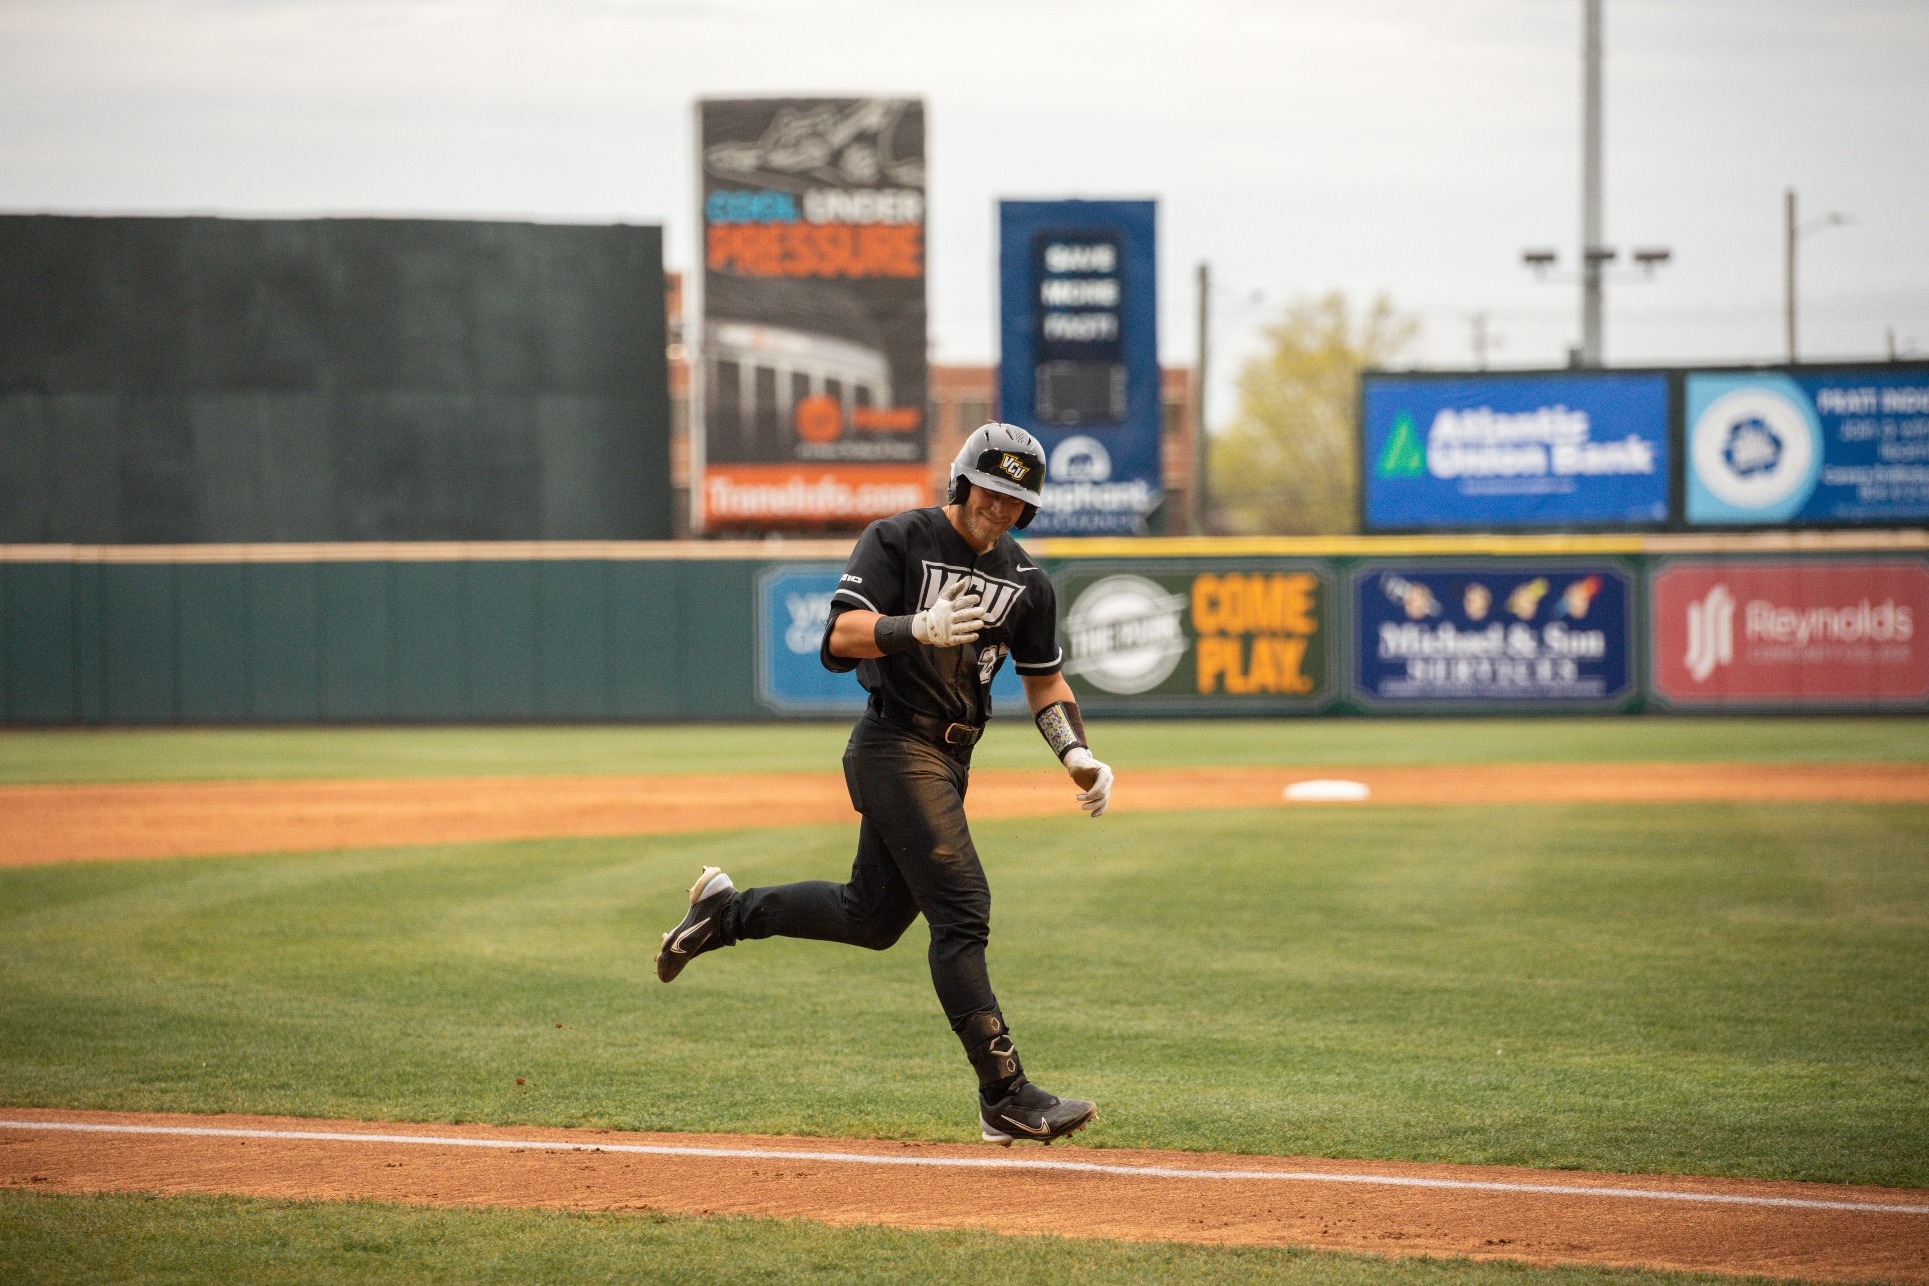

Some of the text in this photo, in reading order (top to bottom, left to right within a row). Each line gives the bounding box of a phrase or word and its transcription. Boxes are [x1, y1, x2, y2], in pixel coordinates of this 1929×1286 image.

[805, 189, 921, 223] UNDER
[709, 222, 921, 276] PRESSURE
[1430, 405, 1588, 443] Atlantic
[1001, 453, 1030, 480] VCU
[1551, 434, 1652, 475] Bank
[1191, 572, 1318, 635] COME
[1746, 598, 1913, 647] Reynolds
[1379, 620, 1605, 659] Michael & Son
